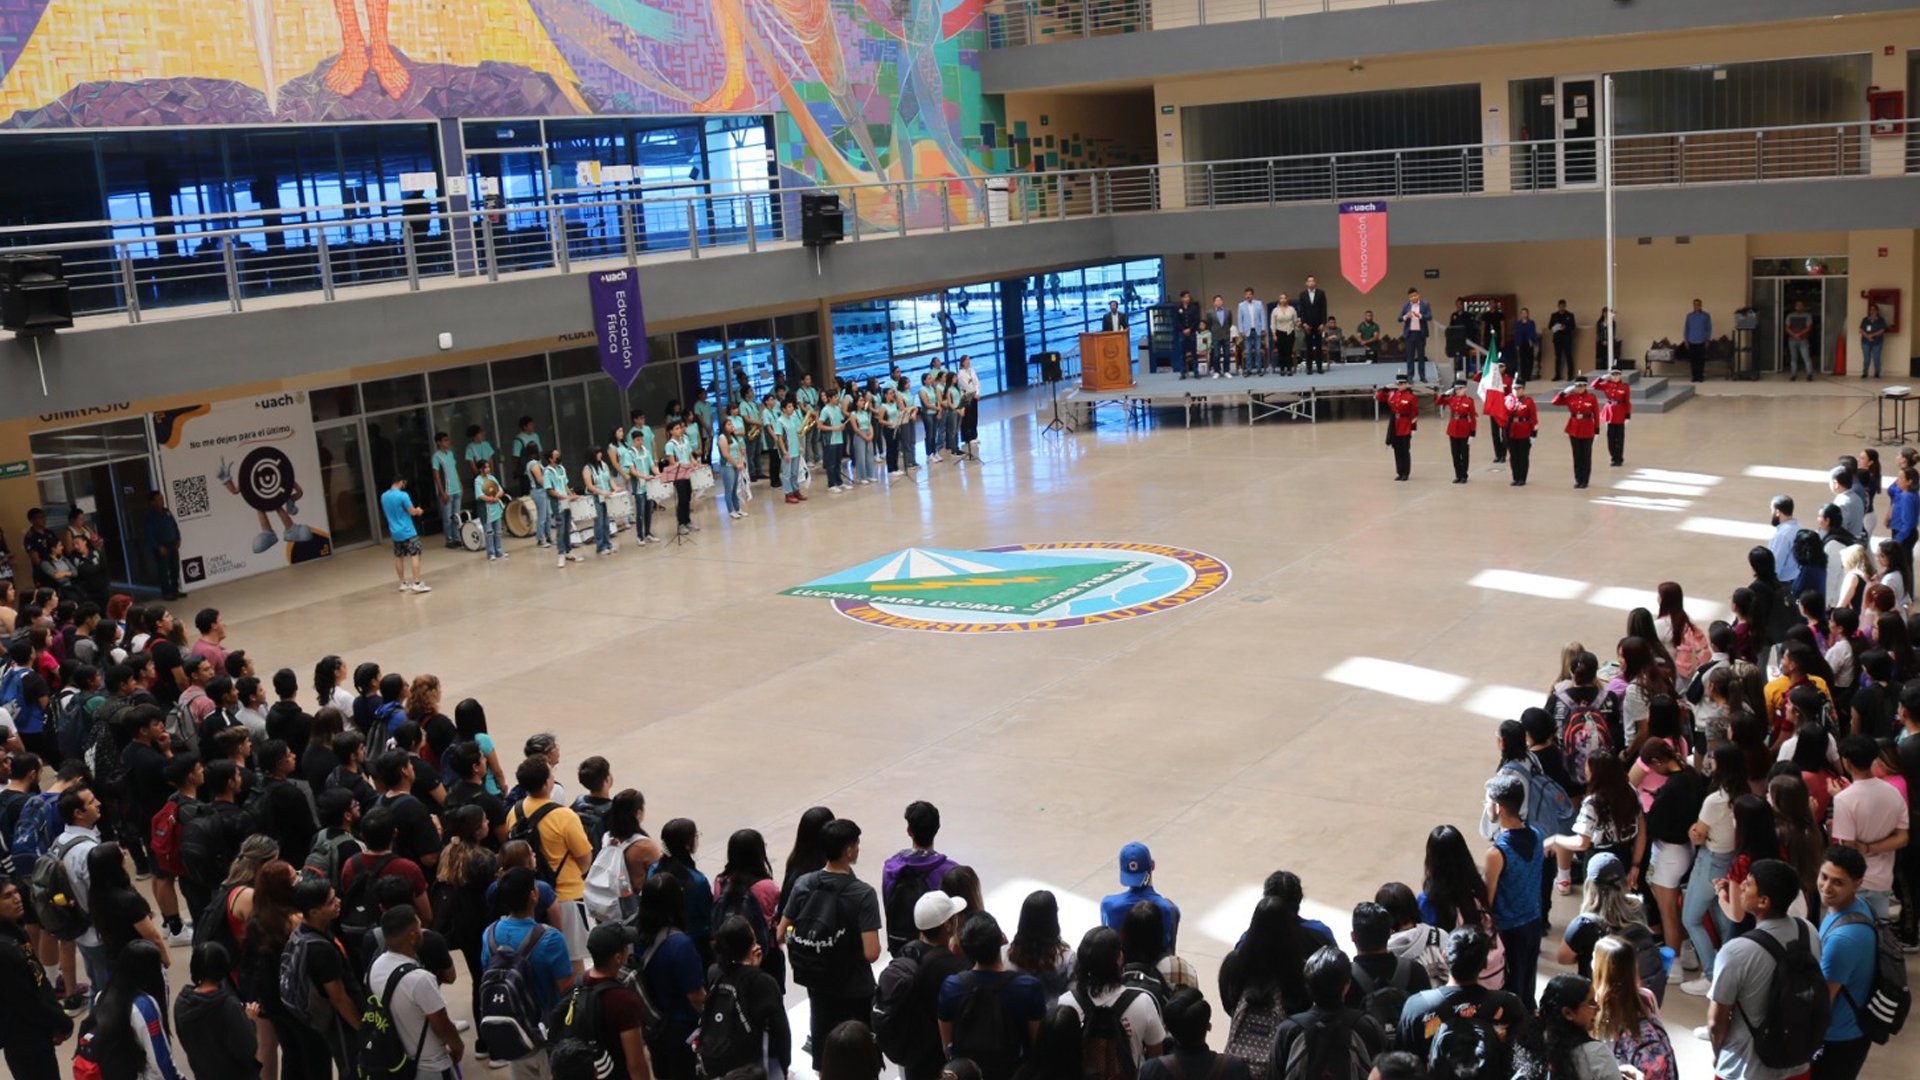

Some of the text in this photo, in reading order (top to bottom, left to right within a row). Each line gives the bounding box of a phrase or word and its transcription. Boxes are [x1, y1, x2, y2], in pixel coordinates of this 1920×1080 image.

[1354, 203, 1376, 212] uach
[605, 270, 628, 282] uach
[615, 290, 632, 369] Educación
[261, 394, 294, 409] uach
[239, 431, 256, 442] para
[791, 588, 1015, 612] LUCHAR PARA LOGRAR
[844, 605, 1058, 632] UNIVERSIDAD
